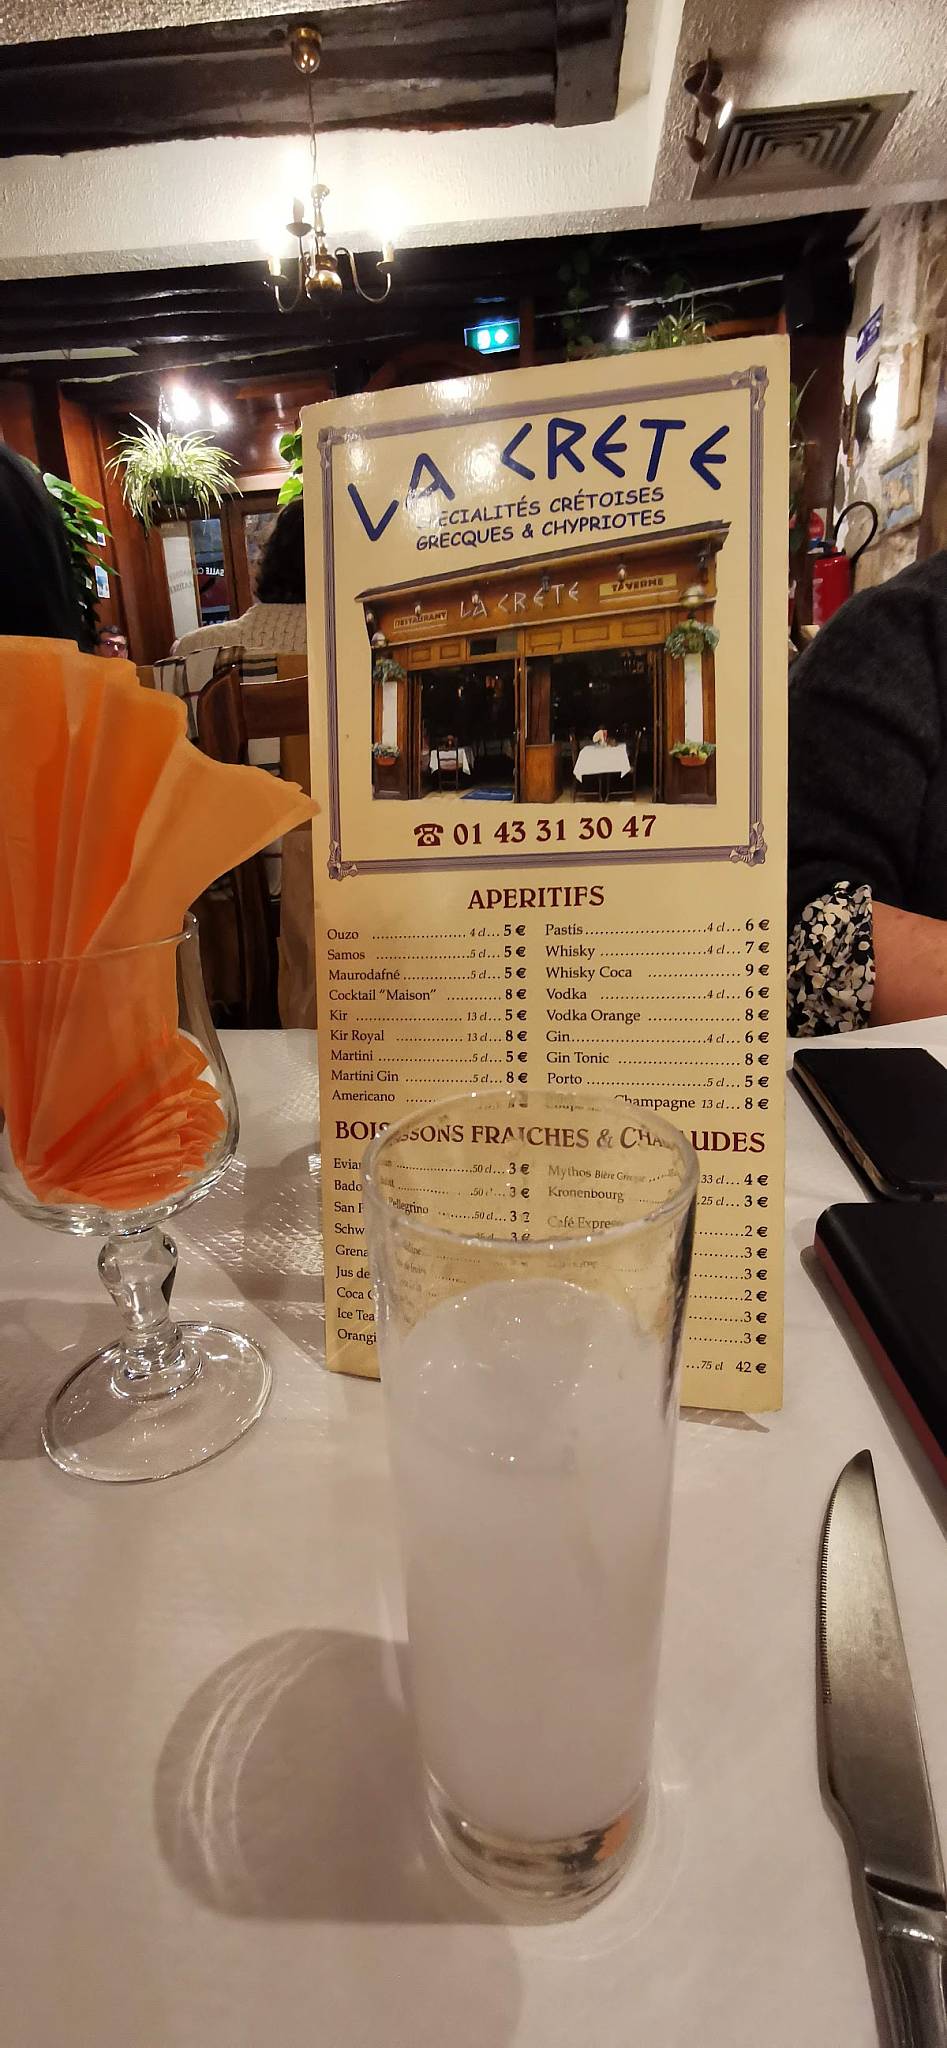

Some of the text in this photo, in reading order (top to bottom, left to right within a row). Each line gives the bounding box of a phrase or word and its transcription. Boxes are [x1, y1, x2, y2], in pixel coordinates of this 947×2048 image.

[347, 414, 730, 541] LA CRETE
[418, 486, 665, 528] ECIALITÉS CRÉTOISES
[416, 509, 667, 551] GRECQUES & CHYPRIOTES
[459, 581, 579, 618] LA CRETE
[453, 814, 657, 846] 01 43 31 30 47
[467, 885, 605, 910] APERITIFS
[327, 924, 525, 940] Ouzo 4 cl 5 €
[546, 919, 769, 935] Pastis 4 cl 6 €
[328, 946, 525, 960] Samos 5 cl 5 €
[546, 941, 769, 960] Whisky 4 cl 7 €
[329, 967, 526, 980] Maurodafné 5 cl 5 €
[546, 964, 769, 982] Whisky Coca 9 €
[329, 989, 375, 1000] Cocktail
[506, 989, 512, 999] 8
[517, 989, 526, 999] €
[547, 986, 769, 999] Vodka 4 cl 6 €
[330, 1009, 527, 1021] Kir 13 cl 5 €
[547, 1009, 769, 1025] Vodka Orange 8 €
[331, 1030, 527, 1044] Kir Royal 13 cl 8 €
[546, 1031, 769, 1043] Gin 4 cl 6 €
[331, 1050, 527, 1062] Martini 5 cl 5 €
[547, 1052, 769, 1065] Gin Tonic 8 €
[331, 1070, 528, 1083] Martini Gin 5 cl 8 €
[548, 1073, 769, 1087] Porto 5 cl 5 €
[332, 1090, 395, 1101] Americano
[702, 1100, 713, 1108] 13
[716, 1100, 724, 1108] cl
[745, 1097, 753, 1109] 8
[758, 1099, 768, 1109] €
[597, 1128, 613, 1149] &
[509, 1162, 516, 1174] 3
[521, 1163, 530, 1175] €
[548, 1165, 592, 1180] Mythos
[701, 1175, 713, 1183] 33
[716, 1175, 724, 1184] cl
[744, 1173, 752, 1185] 4
[757, 1175, 768, 1186] €
[334, 1180, 530, 1198] Bado 3 €
[548, 1186, 768, 1207] Kronenbourg 25 cl 3 €
[334, 1202, 355, 1213] San
[510, 1211, 516, 1222] 3
[745, 1225, 752, 1236] 2
[757, 1227, 767, 1237] €
[744, 1247, 767, 1258] 3 €
[336, 1266, 370, 1278] Jus de
[744, 1269, 767, 1280] 3 €
[337, 1287, 363, 1299] Coca
[744, 1290, 767, 1302] 2 €
[338, 1308, 375, 1321] Ice Tea
[744, 1311, 767, 1323] 3 €
[338, 1329, 376, 1345] Orangi
[744, 1333, 767, 1344] 3 €
[701, 1361, 766, 1373] 75 cl 42 €
